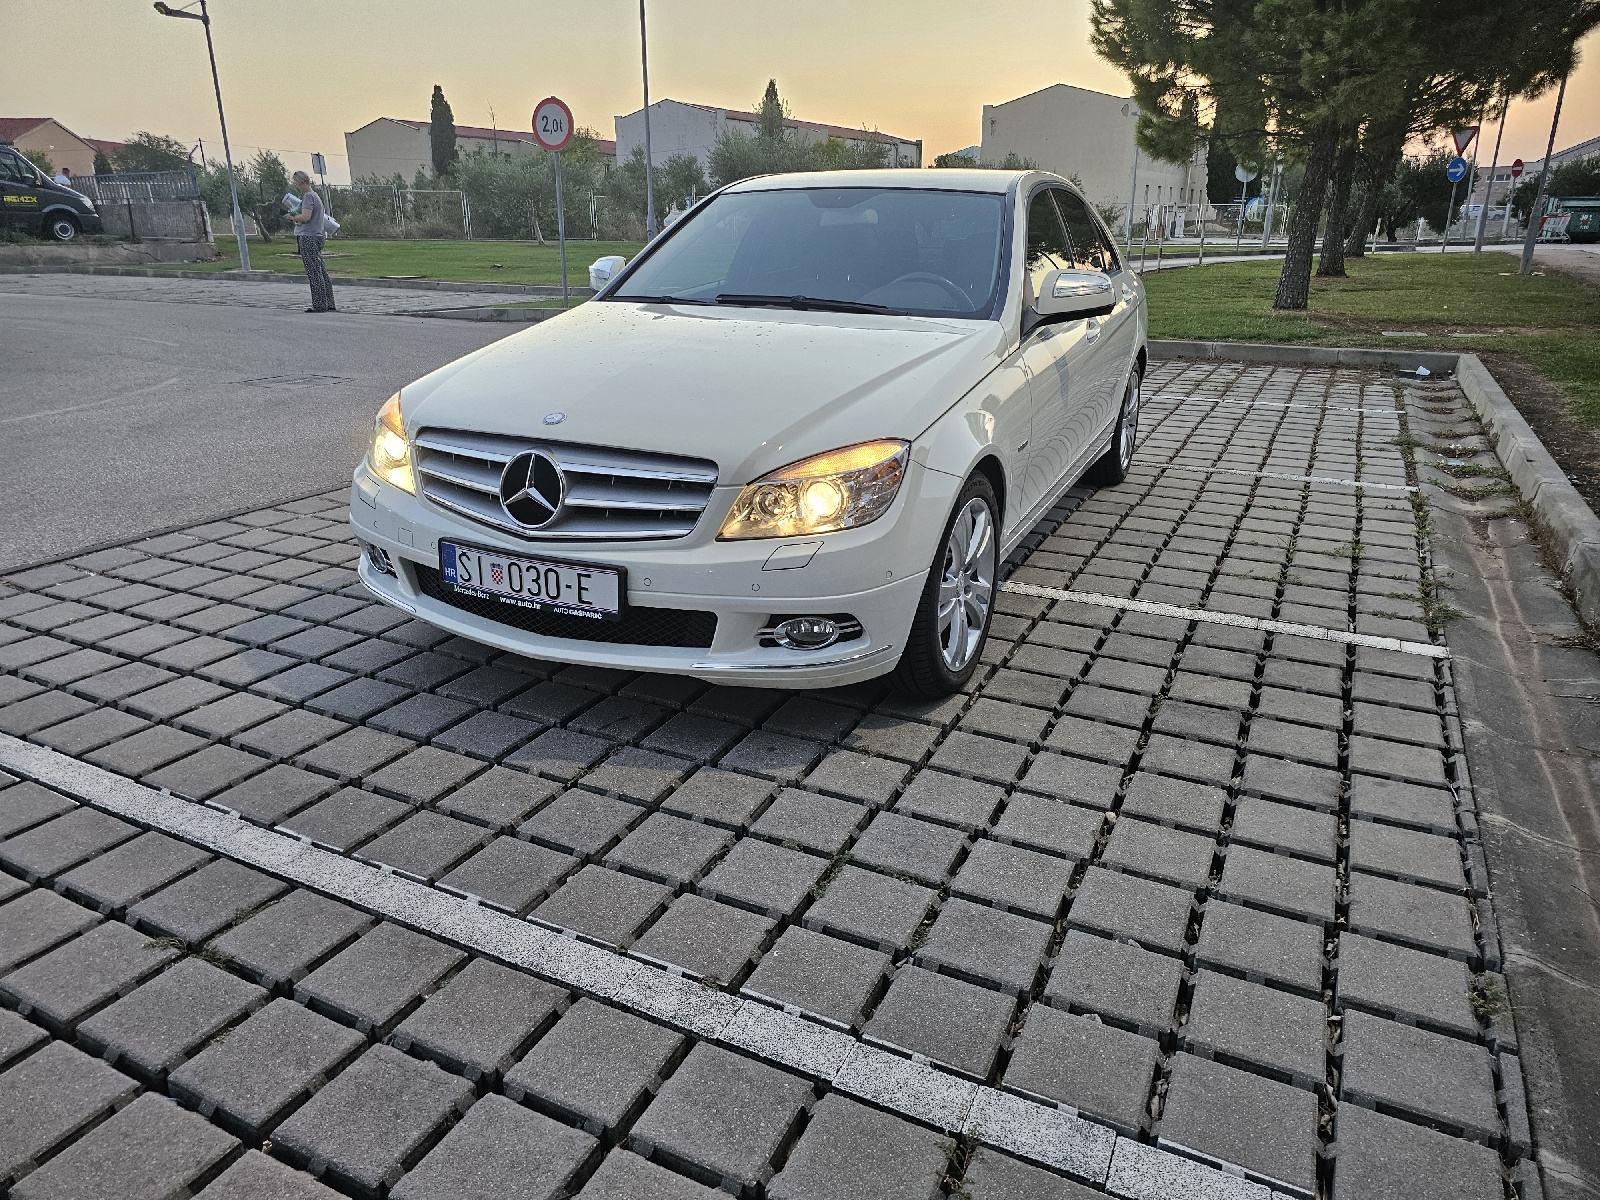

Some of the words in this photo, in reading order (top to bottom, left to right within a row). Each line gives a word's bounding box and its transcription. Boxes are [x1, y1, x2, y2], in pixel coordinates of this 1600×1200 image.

[444, 567, 457, 579] HR
[508, 561, 593, 605] 030-E
[500, 596, 542, 611] www.auto.hr
[553, 607, 569, 615] AUTO
